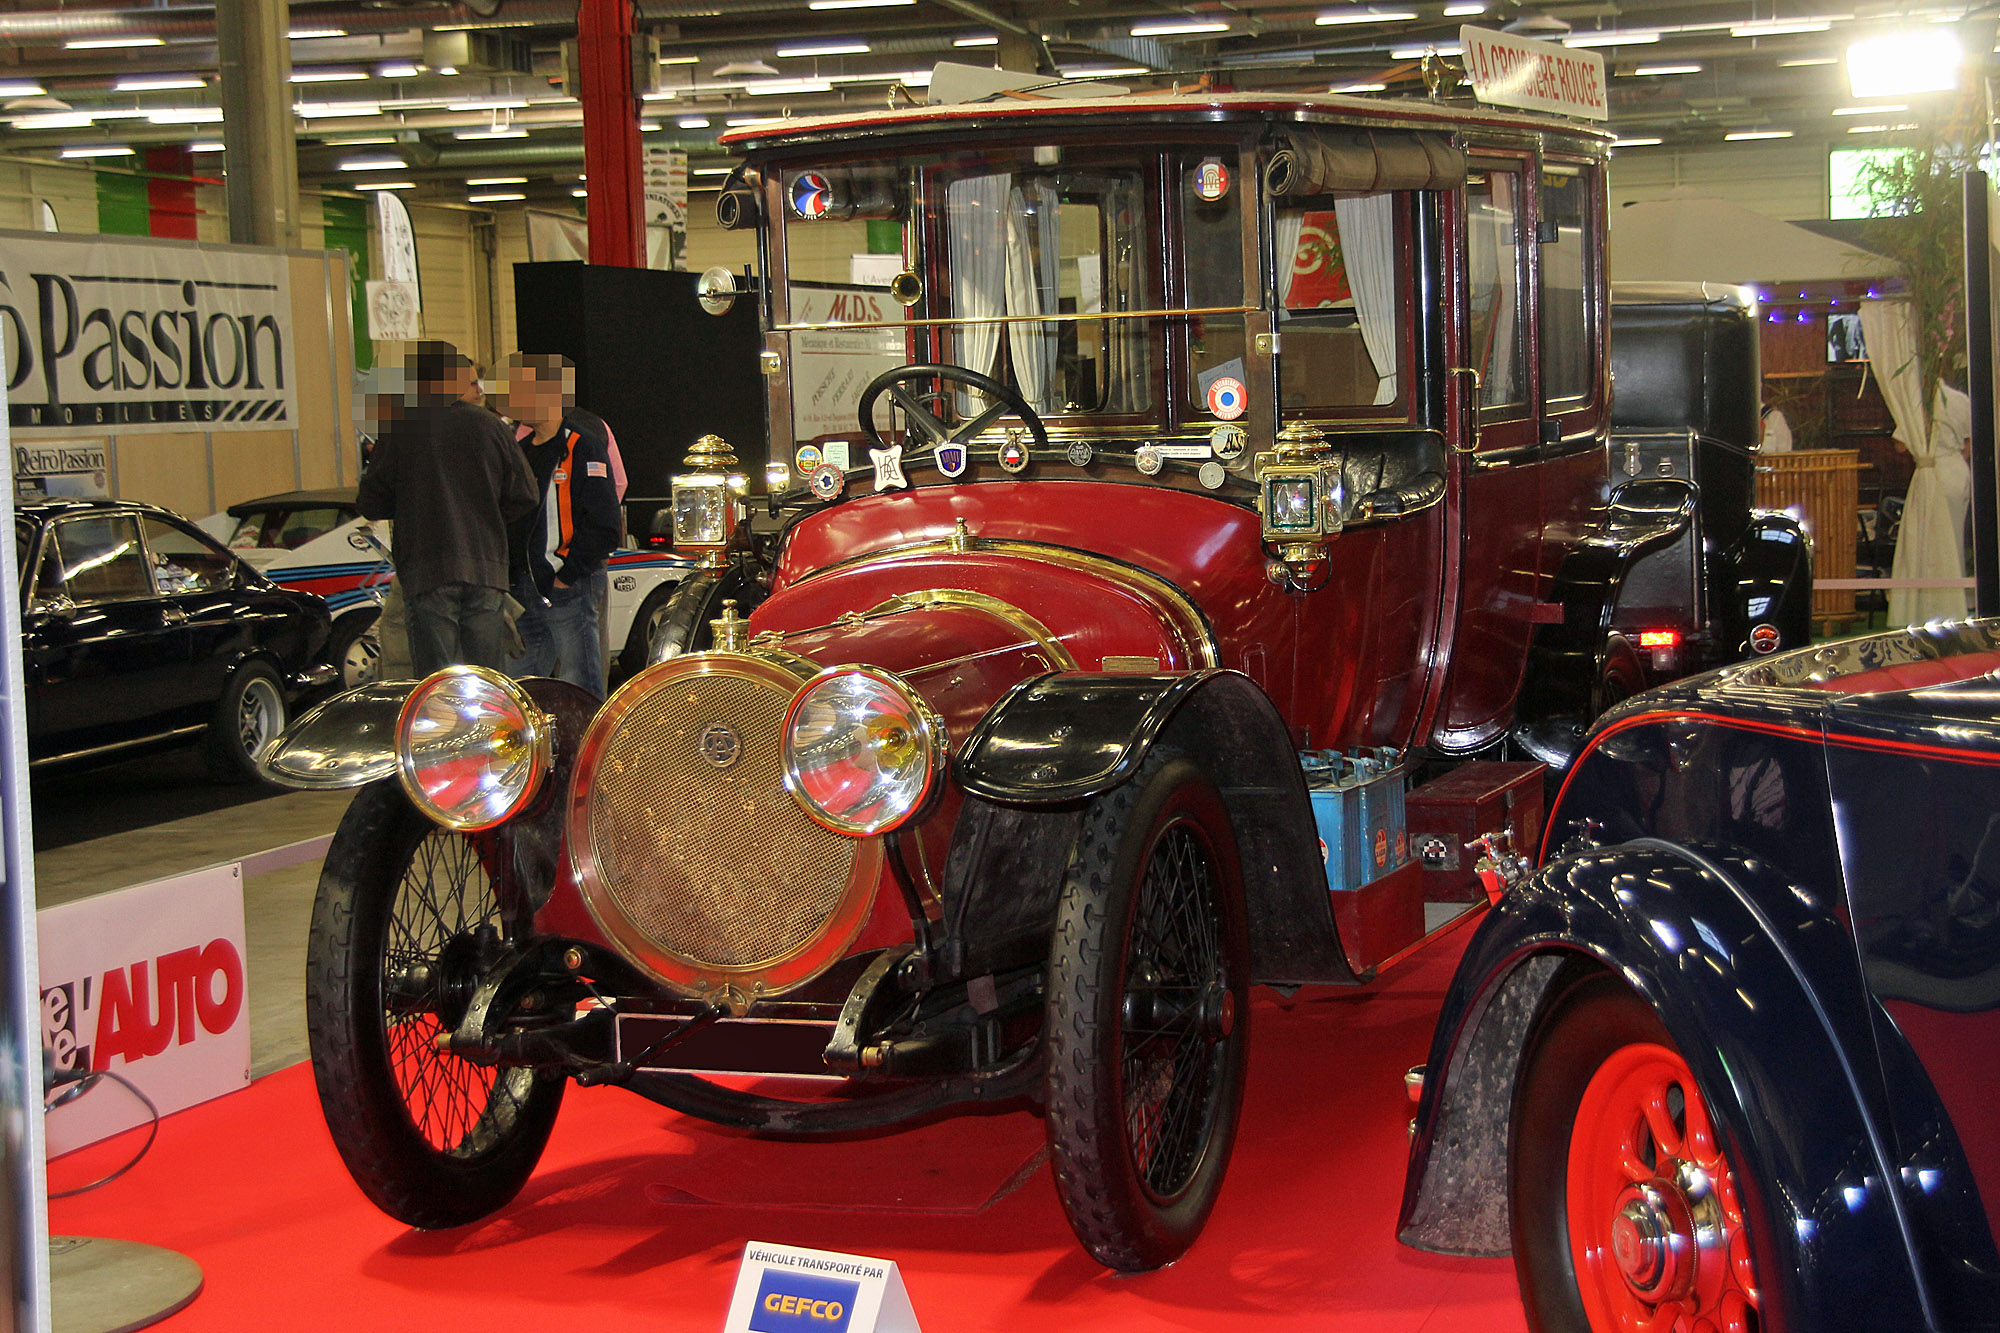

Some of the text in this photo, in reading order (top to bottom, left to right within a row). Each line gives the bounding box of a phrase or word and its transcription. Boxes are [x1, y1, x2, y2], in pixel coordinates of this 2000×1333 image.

[1469, 40, 1491, 86] LA
[1557, 58, 1601, 107] ROUGE
[645, 193, 681, 218] INIATURES
[30, 273, 285, 407] Passion
[749, 1250, 884, 1279] VÉHICULE TRANSPORTÉ PAR
[764, 1293, 844, 1321] GEFCO
